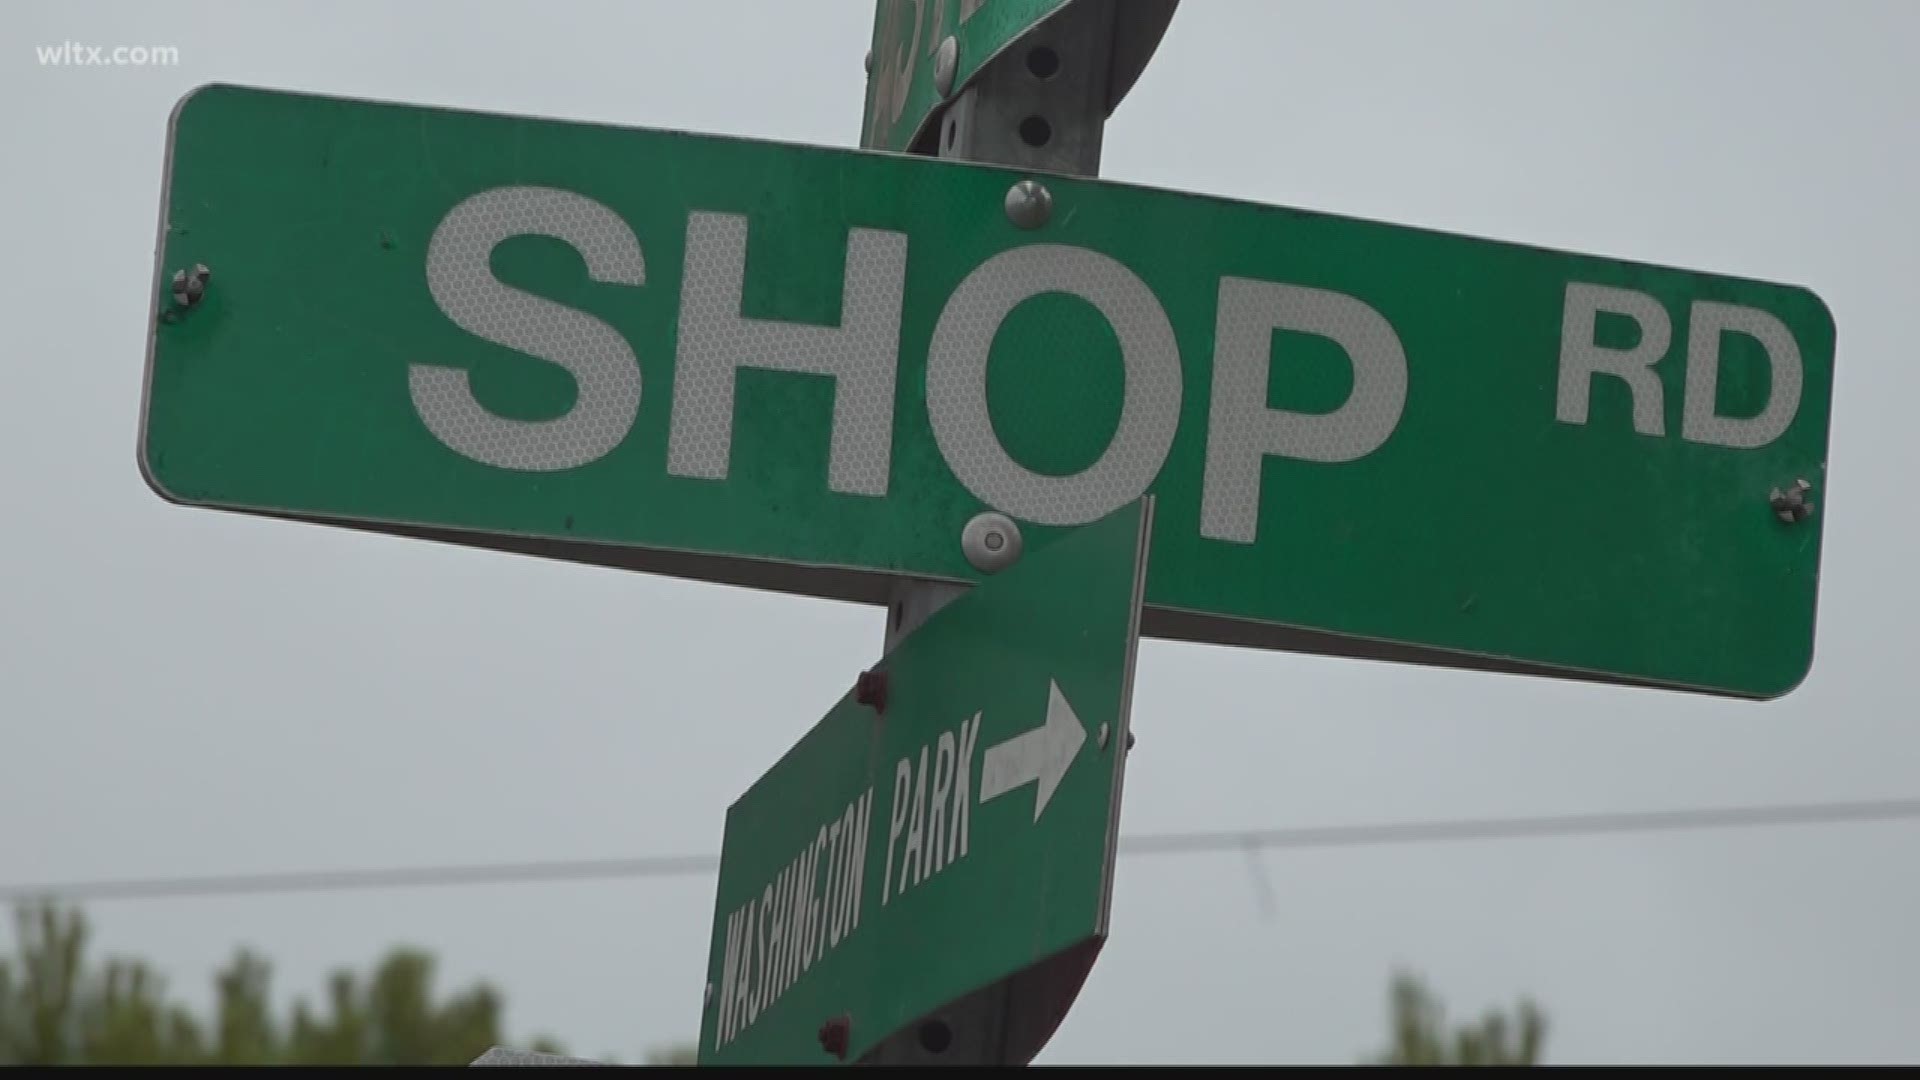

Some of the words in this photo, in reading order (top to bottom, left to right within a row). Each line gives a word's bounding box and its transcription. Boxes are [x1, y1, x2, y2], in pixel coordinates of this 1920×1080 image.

[407, 184, 1409, 545] SHOP
[1555, 281, 1803, 449] RD
[715, 786, 873, 1051] WASHINGTON
[881, 710, 982, 906] PARK
